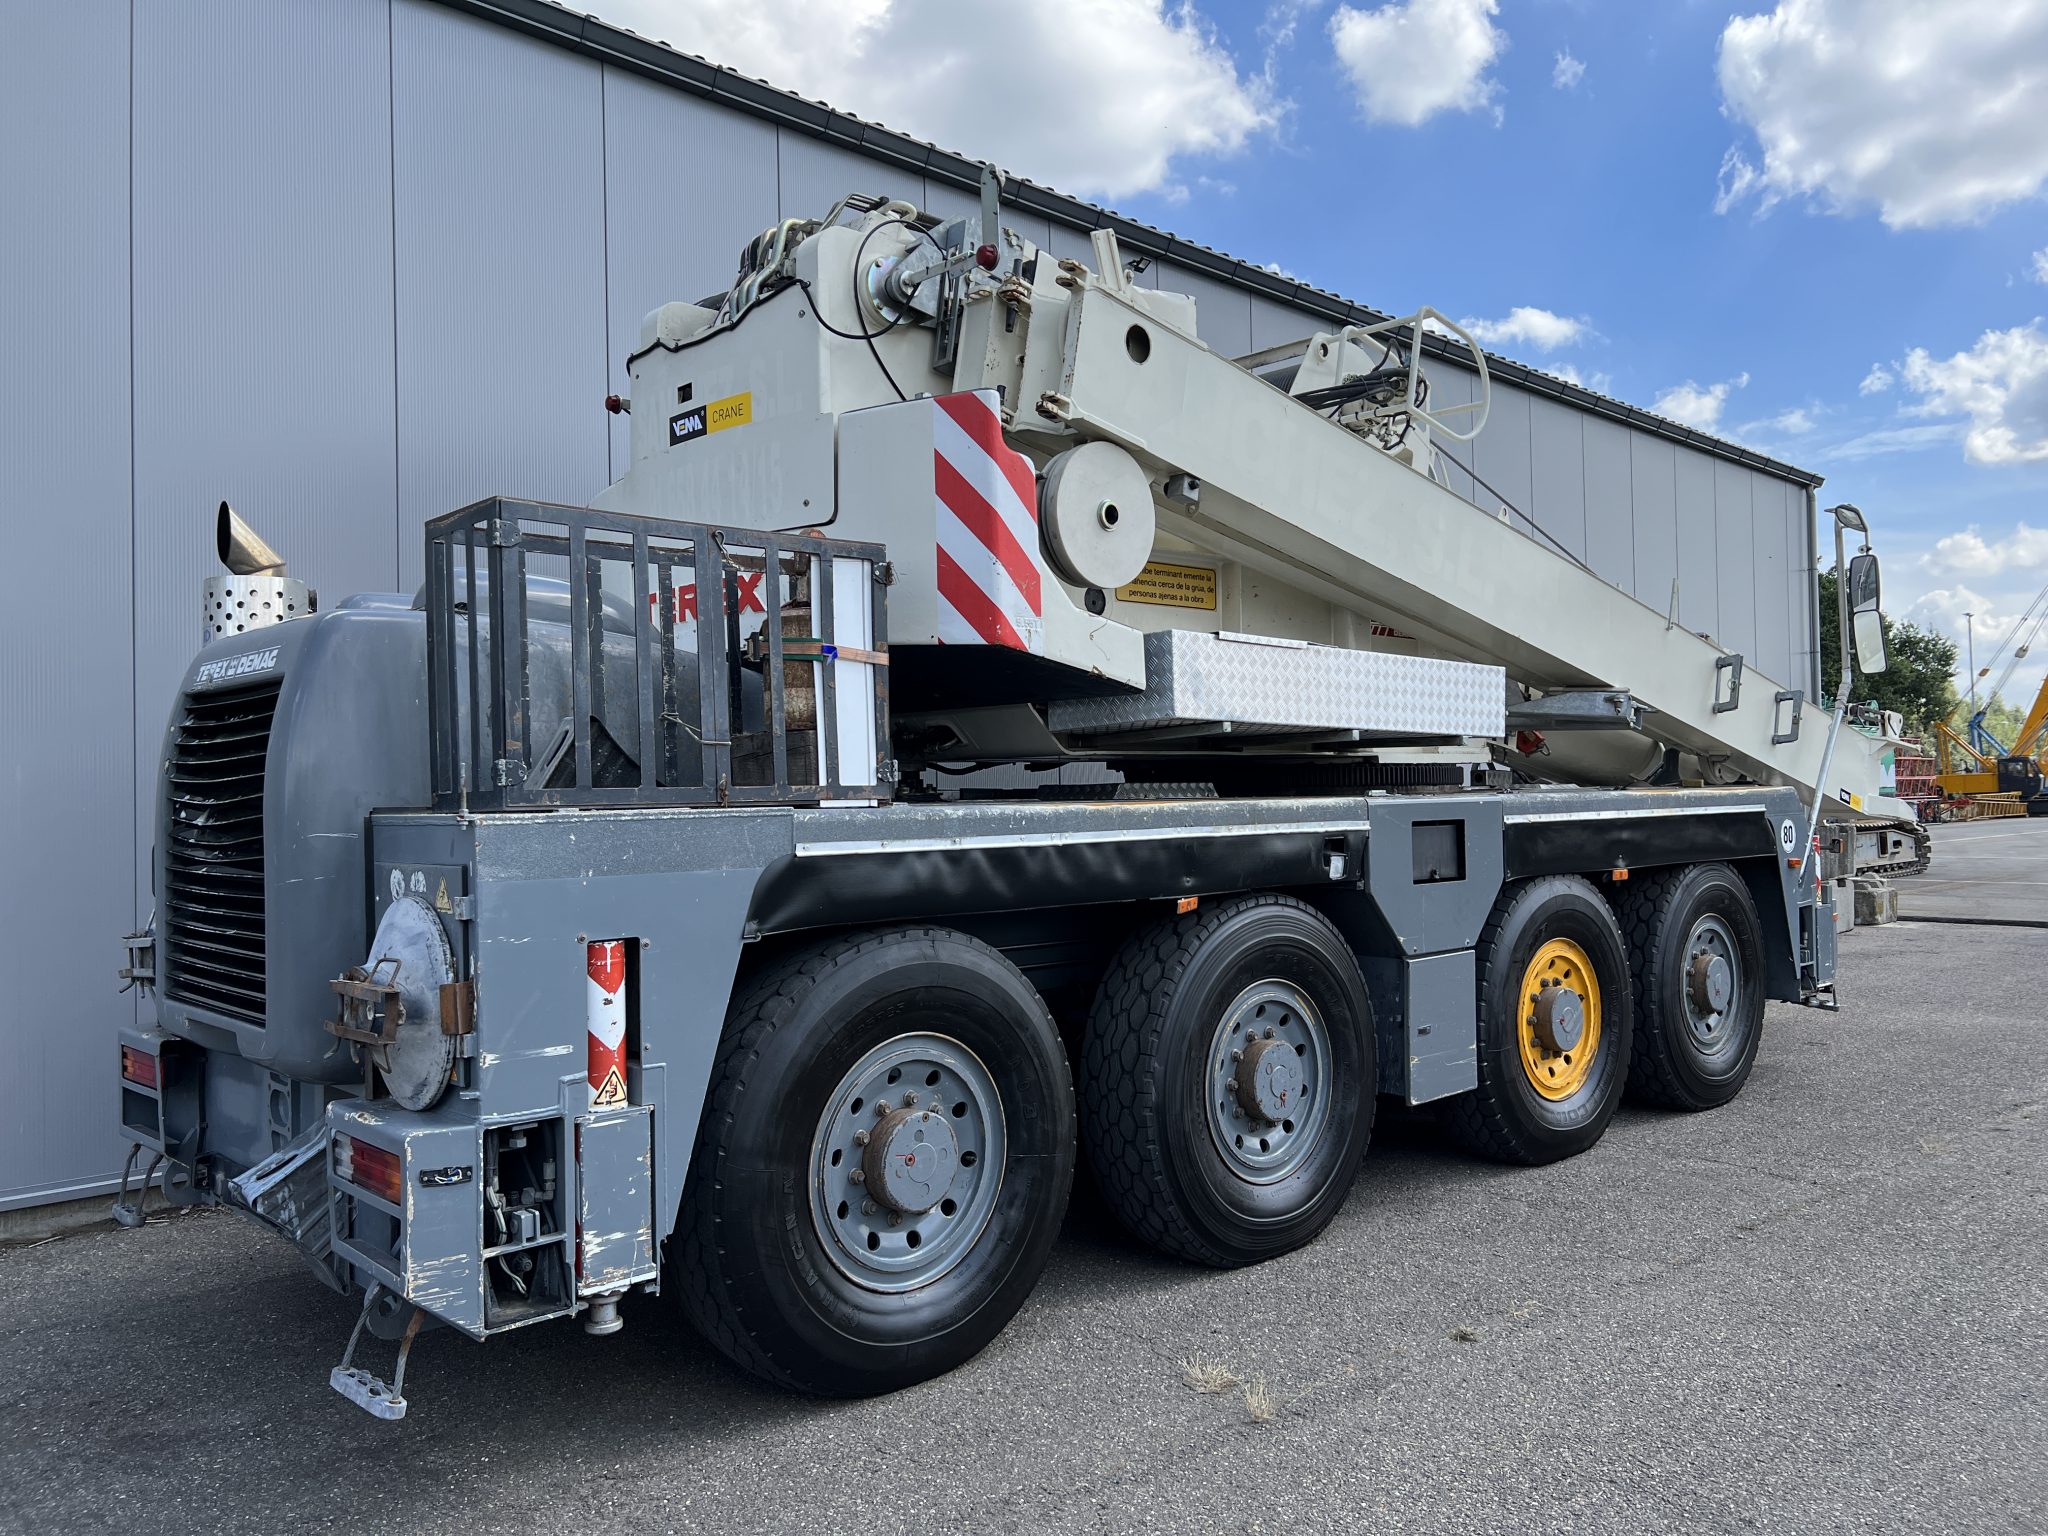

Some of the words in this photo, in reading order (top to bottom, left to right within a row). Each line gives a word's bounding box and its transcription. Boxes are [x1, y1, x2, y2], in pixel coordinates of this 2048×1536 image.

[712, 402, 744, 424] CRANE
[1128, 589, 1158, 599] personas
[235, 649, 279, 674] DEMAG
[1783, 825, 1793, 844] 80
